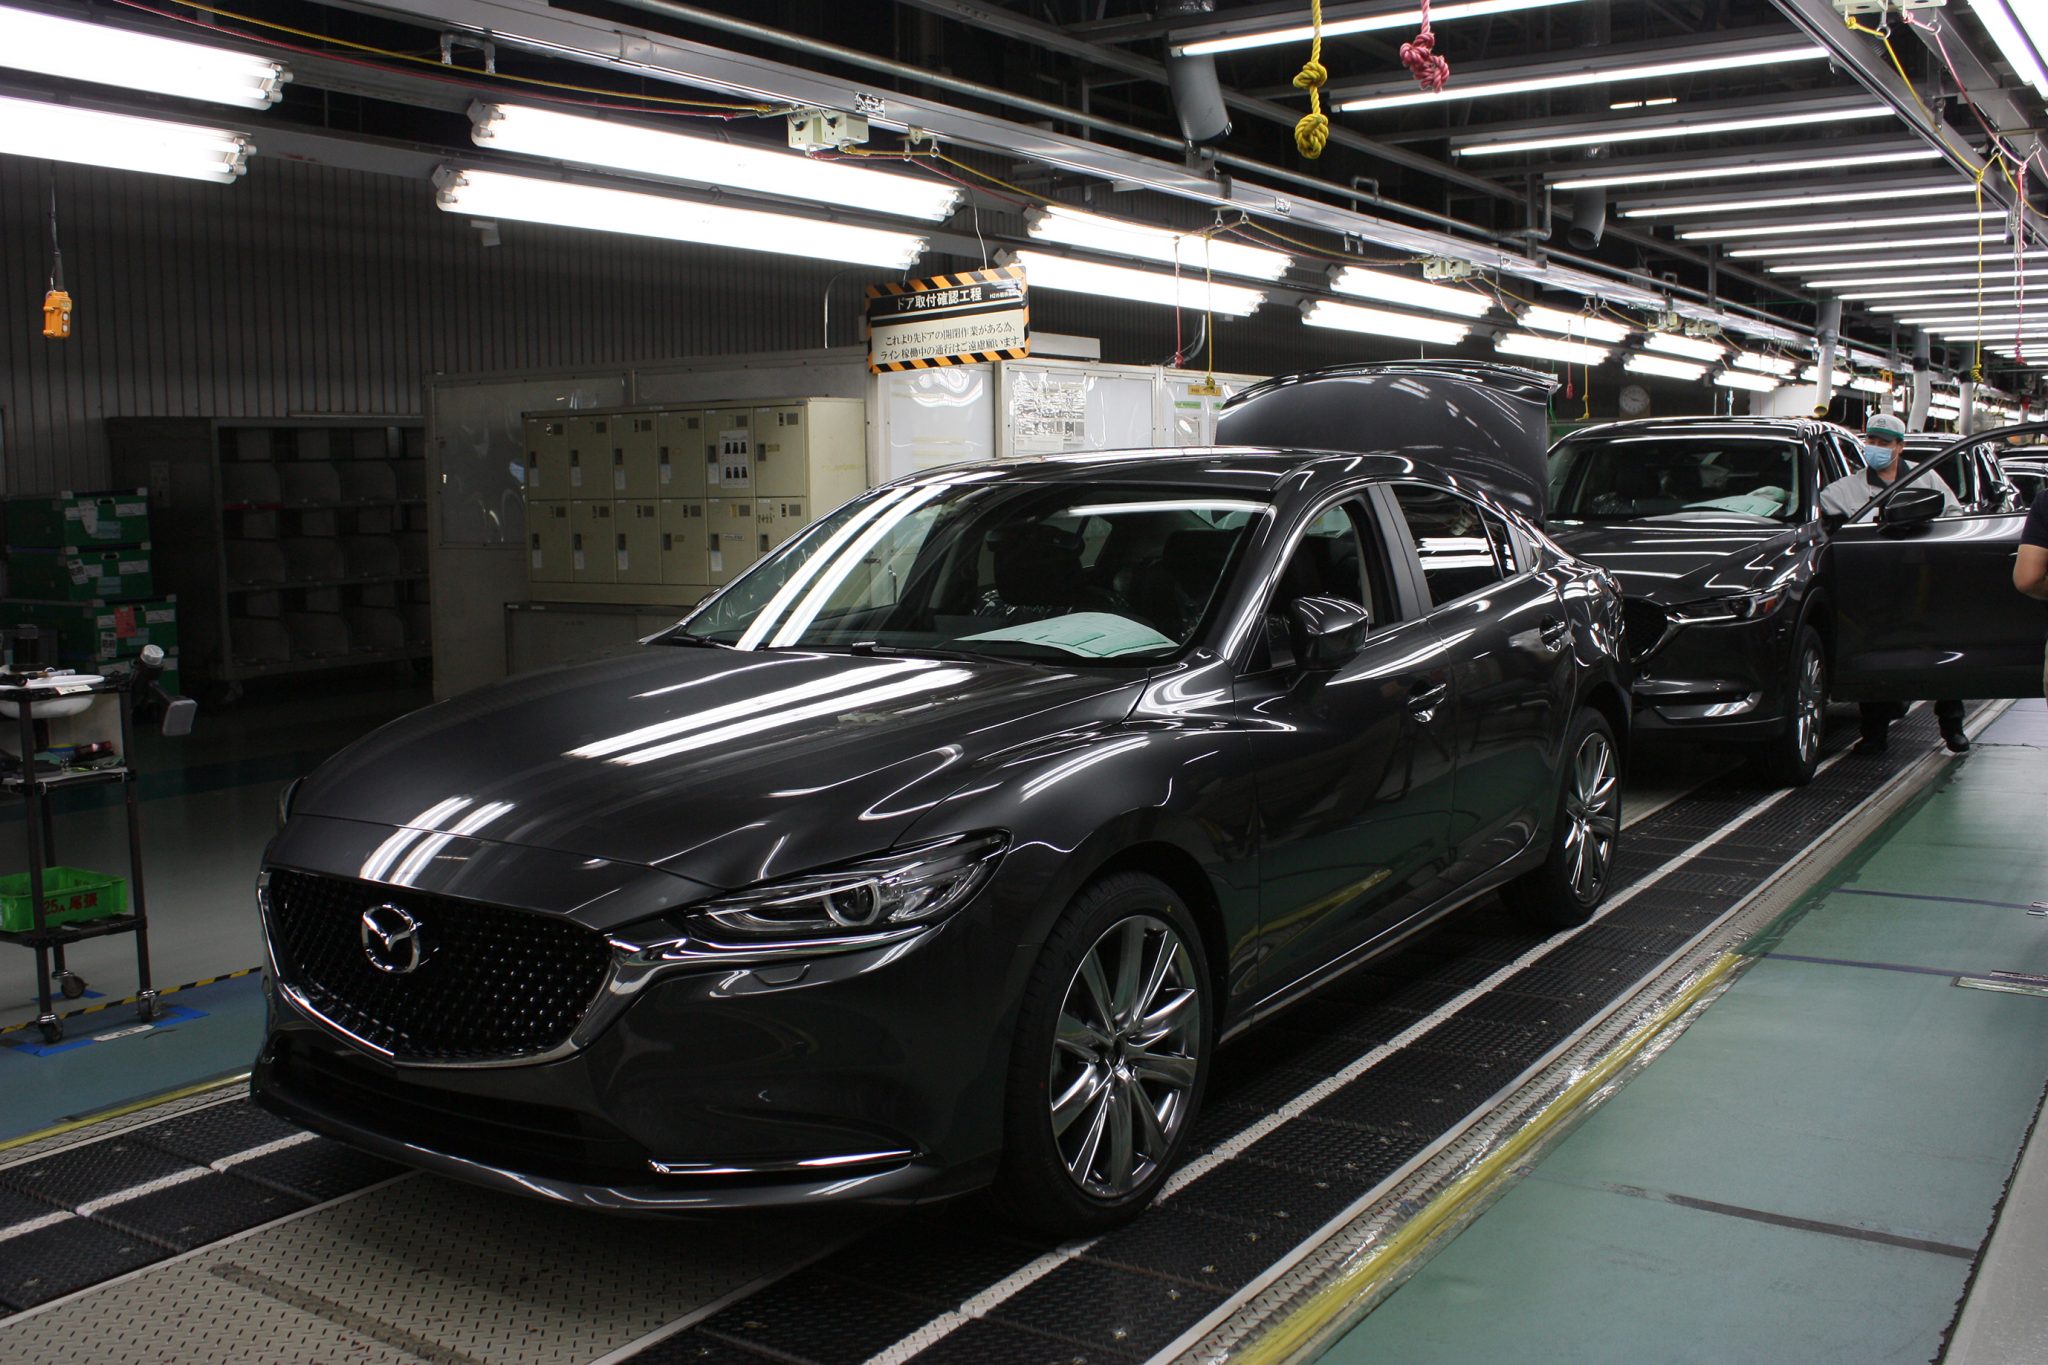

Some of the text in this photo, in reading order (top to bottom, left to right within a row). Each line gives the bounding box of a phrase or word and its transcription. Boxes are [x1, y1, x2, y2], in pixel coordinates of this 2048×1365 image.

[897, 287, 982, 310] ドア取付確認工程
